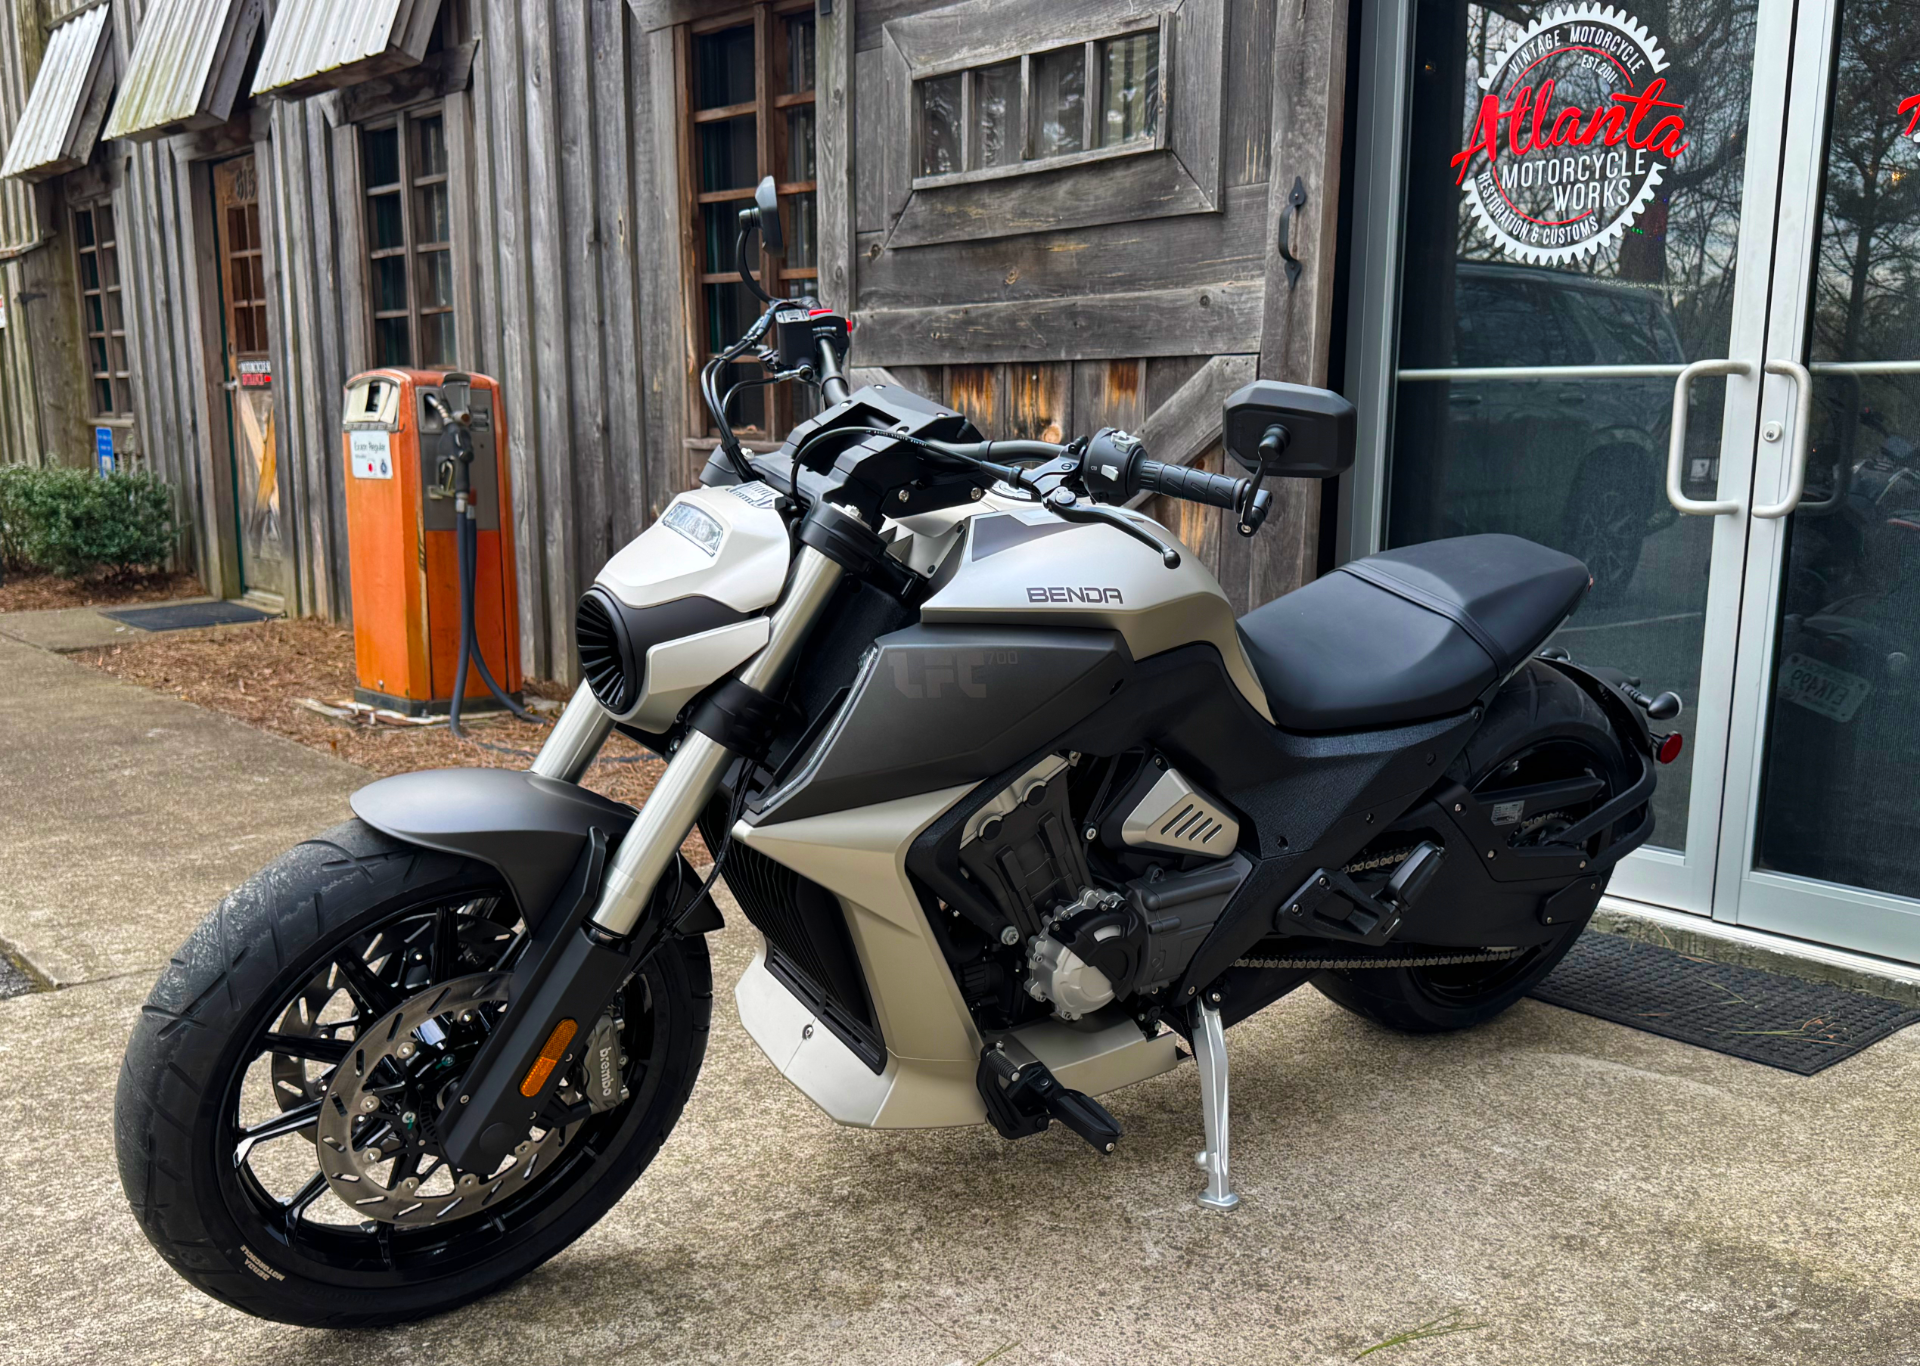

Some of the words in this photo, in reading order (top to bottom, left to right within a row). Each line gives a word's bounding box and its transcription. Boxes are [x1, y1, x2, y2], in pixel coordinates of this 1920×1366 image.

[1509, 29, 1561, 74] VINTAGE
[1569, 26, 1646, 75] MOTORCYCLE
[1451, 78, 1690, 185] Atlanta
[1501, 149, 1647, 190] MOTORCYCLE
[1477, 171, 1528, 243] RESTORATION
[1530, 225, 1539, 244] &
[1542, 216, 1599, 245] CUSTOMS
[1552, 178, 1631, 212] WORKS
[1026, 586, 1124, 605] BENDA
[986, 651, 1018, 665] 700
[599, 1046, 614, 1097] brembo
[240, 1244, 286, 1281] MOTORCYCLE
